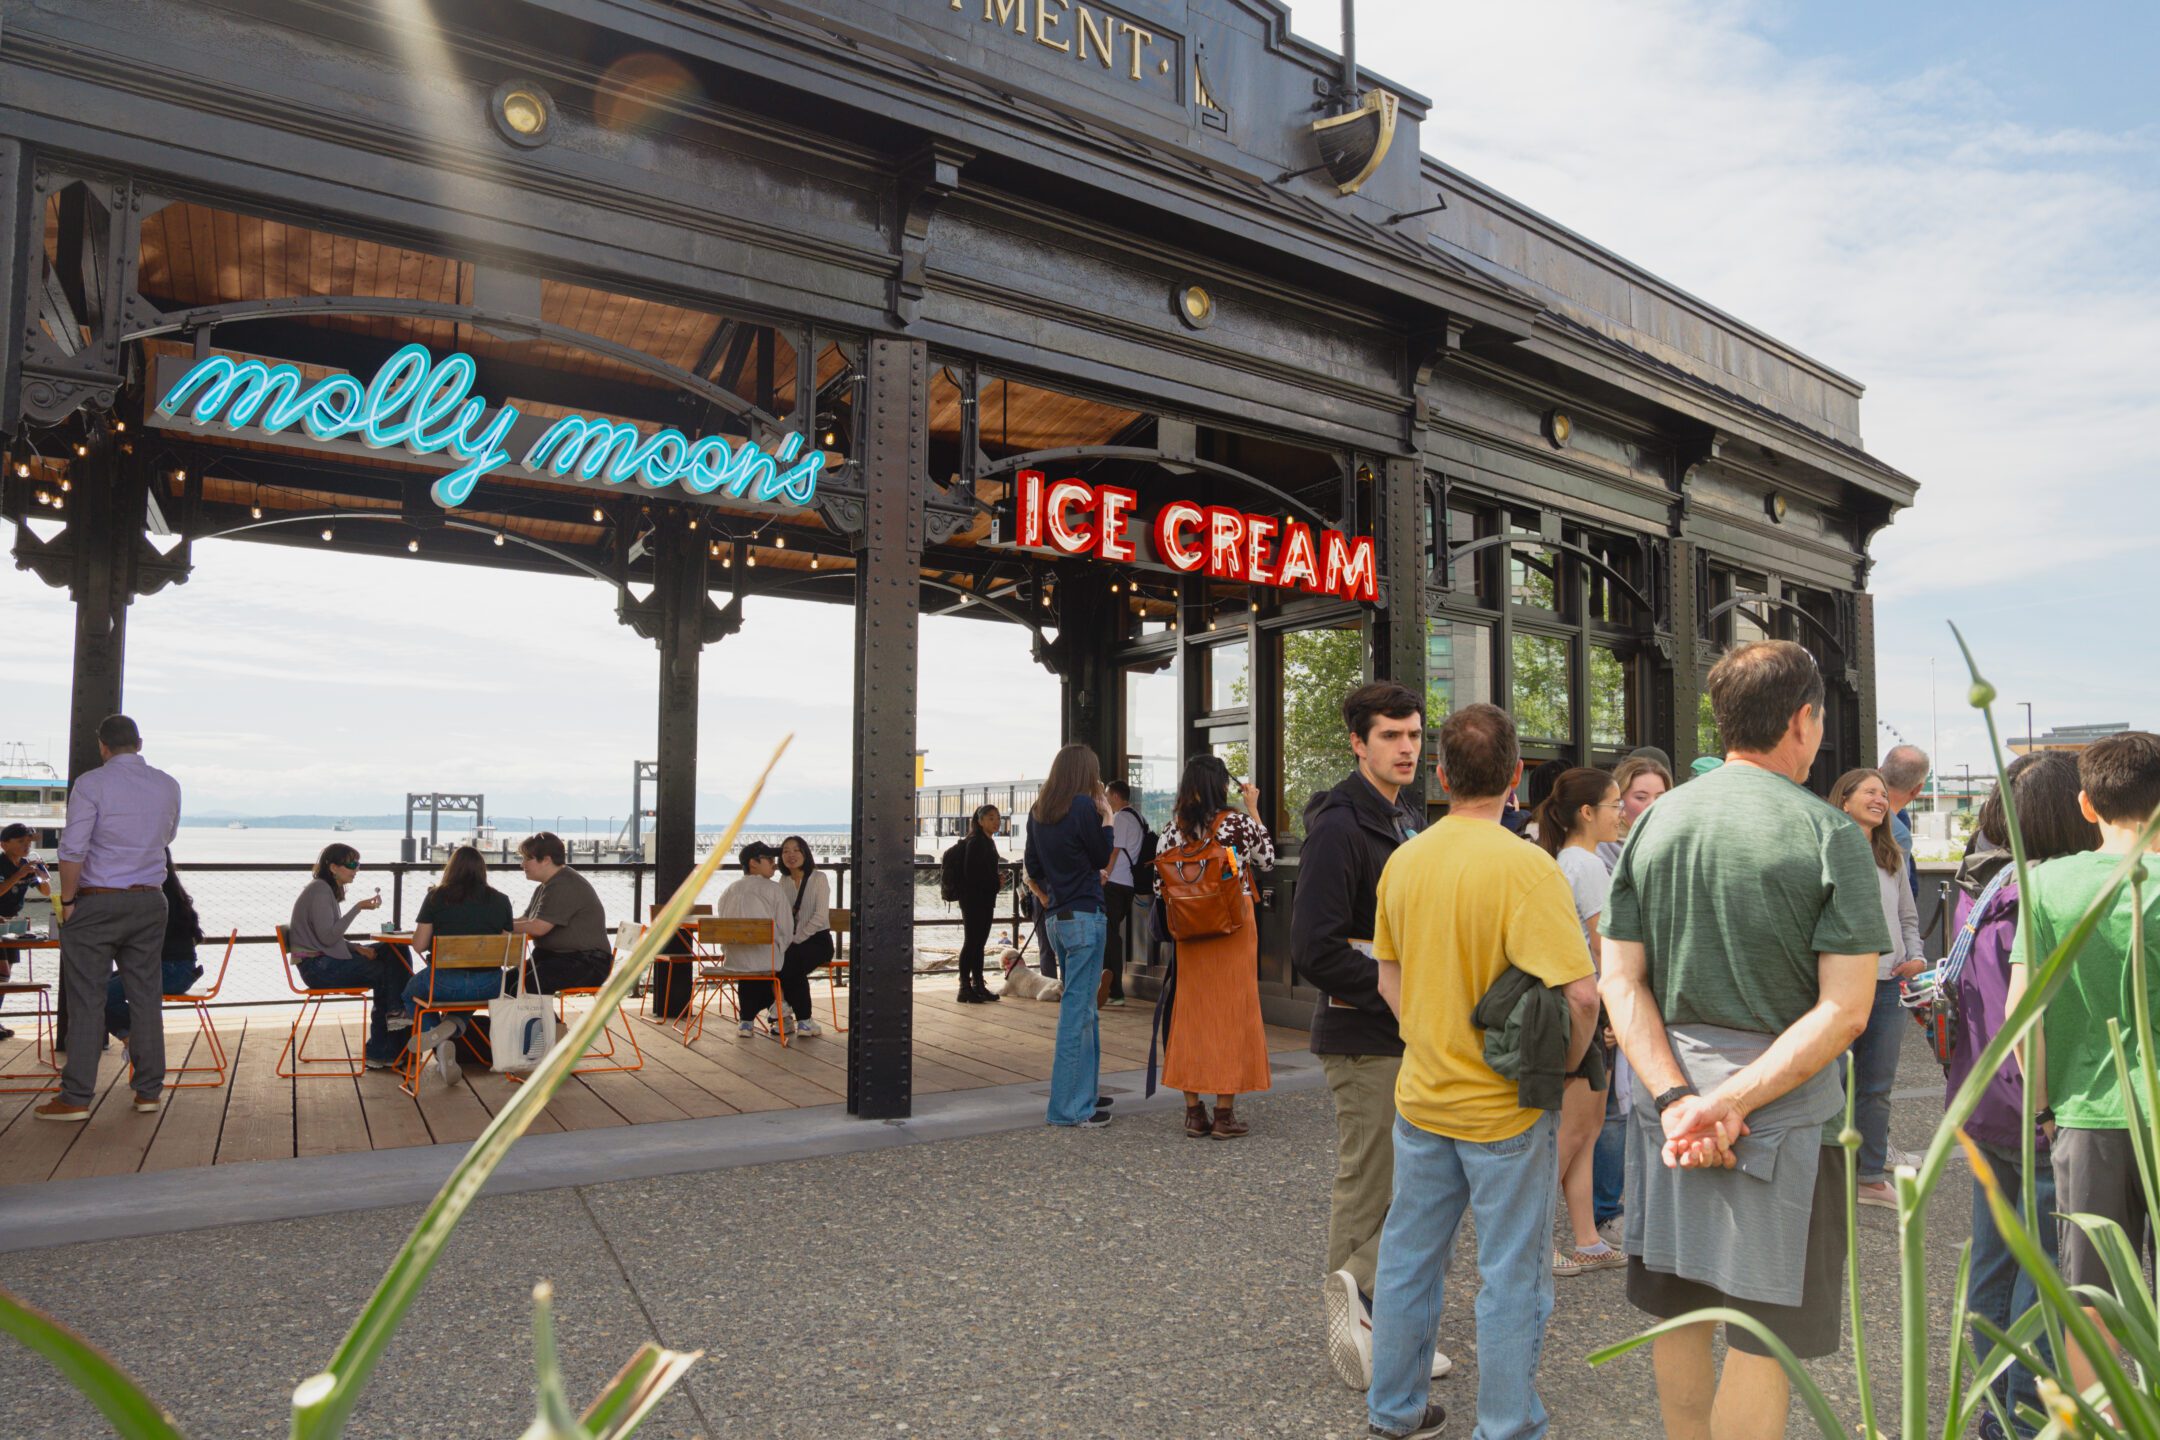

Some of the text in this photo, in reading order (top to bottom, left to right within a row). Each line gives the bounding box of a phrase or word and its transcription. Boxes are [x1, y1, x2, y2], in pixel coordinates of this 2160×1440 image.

[950, 0, 1152, 80] MENT
[155, 343, 826, 508] molly moon's
[1016, 470, 1379, 602] ICE CREAM
